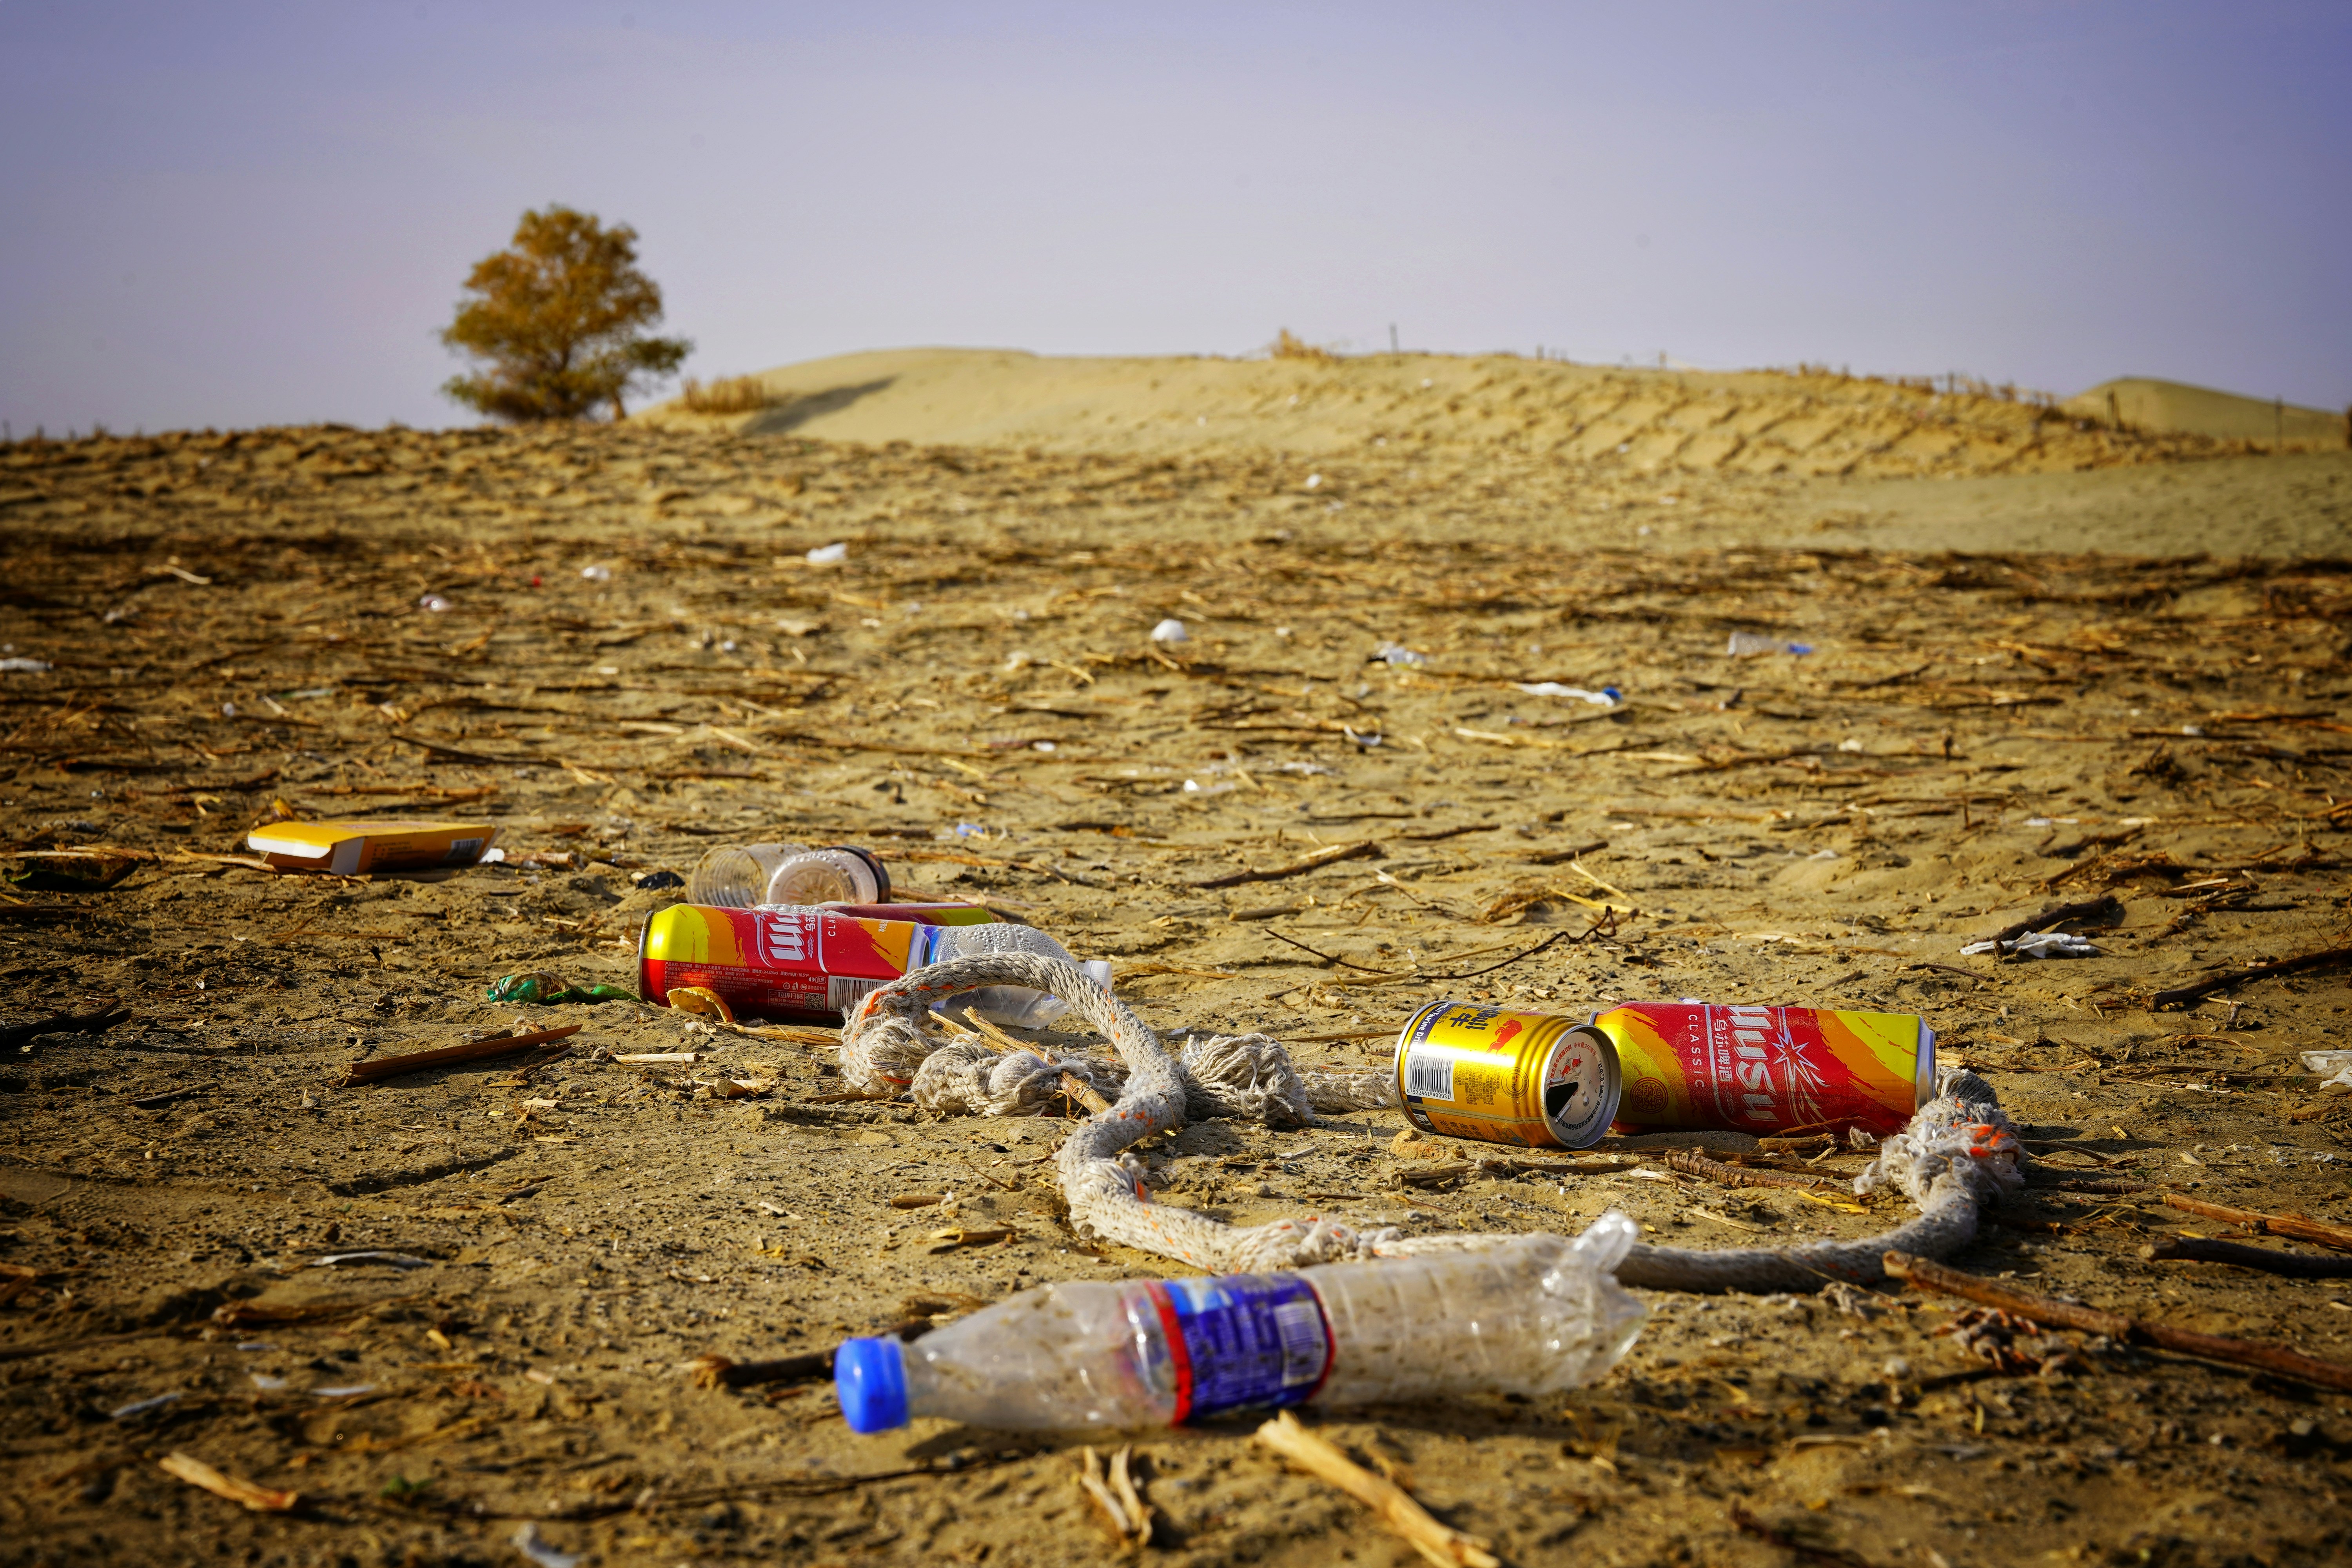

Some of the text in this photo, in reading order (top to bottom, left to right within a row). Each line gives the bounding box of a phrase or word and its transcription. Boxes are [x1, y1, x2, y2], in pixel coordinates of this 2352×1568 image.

[778, 991, 803, 1000] 拉环扫码
[1418, 1010, 1440, 1031] Taurine
[1688, 1014, 1704, 1088] CLASSIC
[1713, 1018, 1733, 1082] 乌苏啤酒
